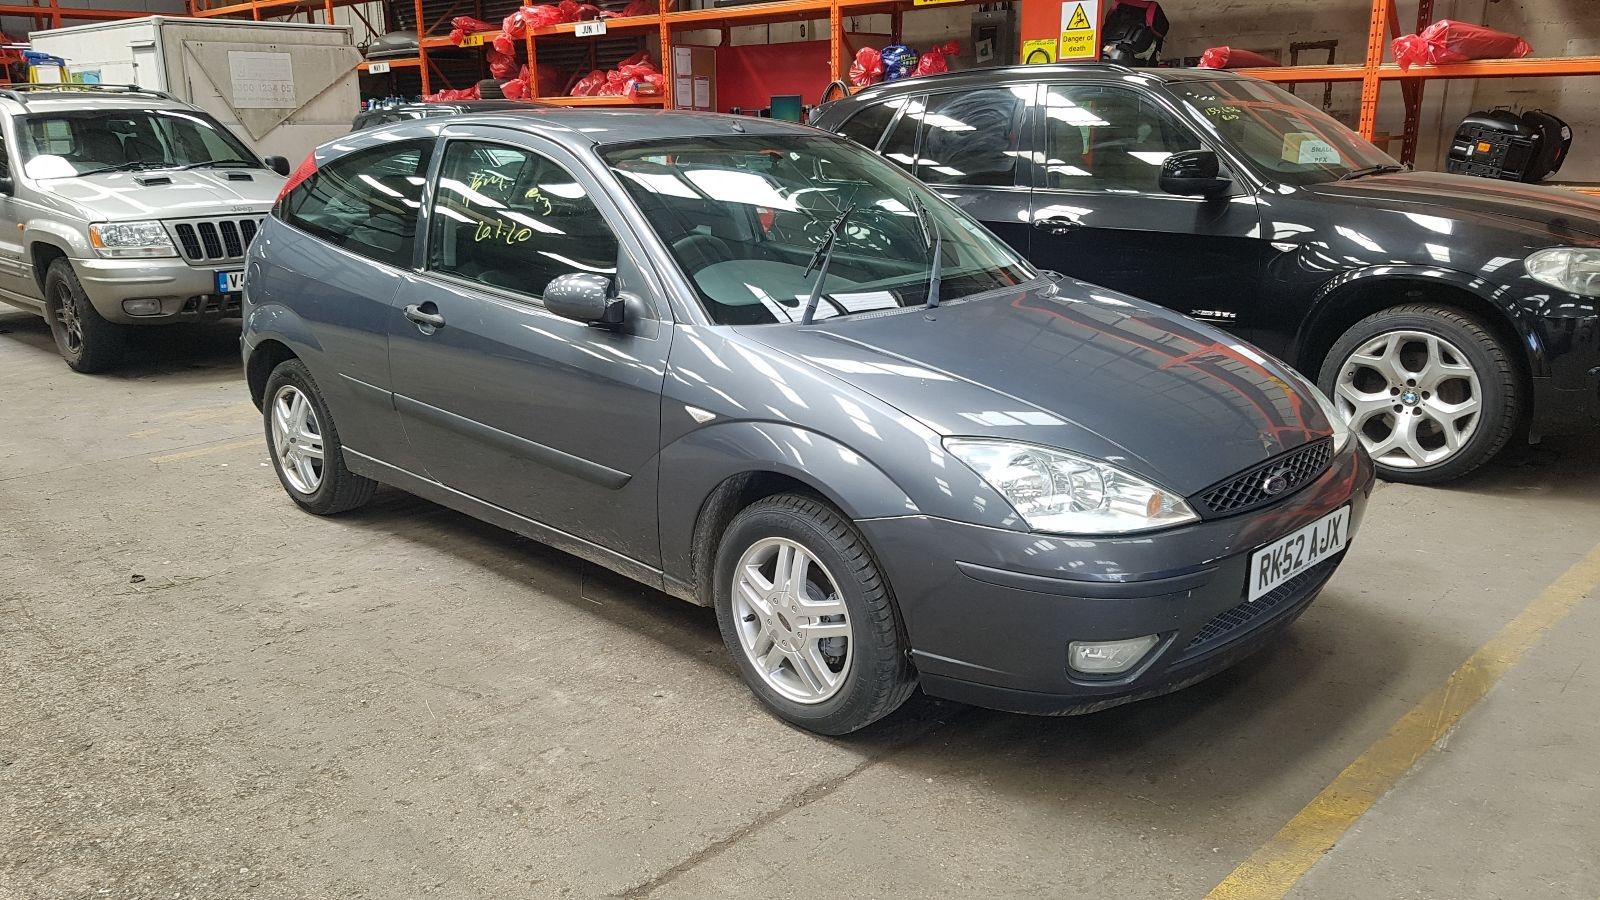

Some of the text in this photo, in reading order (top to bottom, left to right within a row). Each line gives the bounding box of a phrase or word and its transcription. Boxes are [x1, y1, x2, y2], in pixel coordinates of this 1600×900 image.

[582, 25, 593, 34] JUN
[1063, 36, 1085, 44] Danger
[1087, 34, 1094, 42] of
[1258, 513, 1342, 591] RK52 AJX
